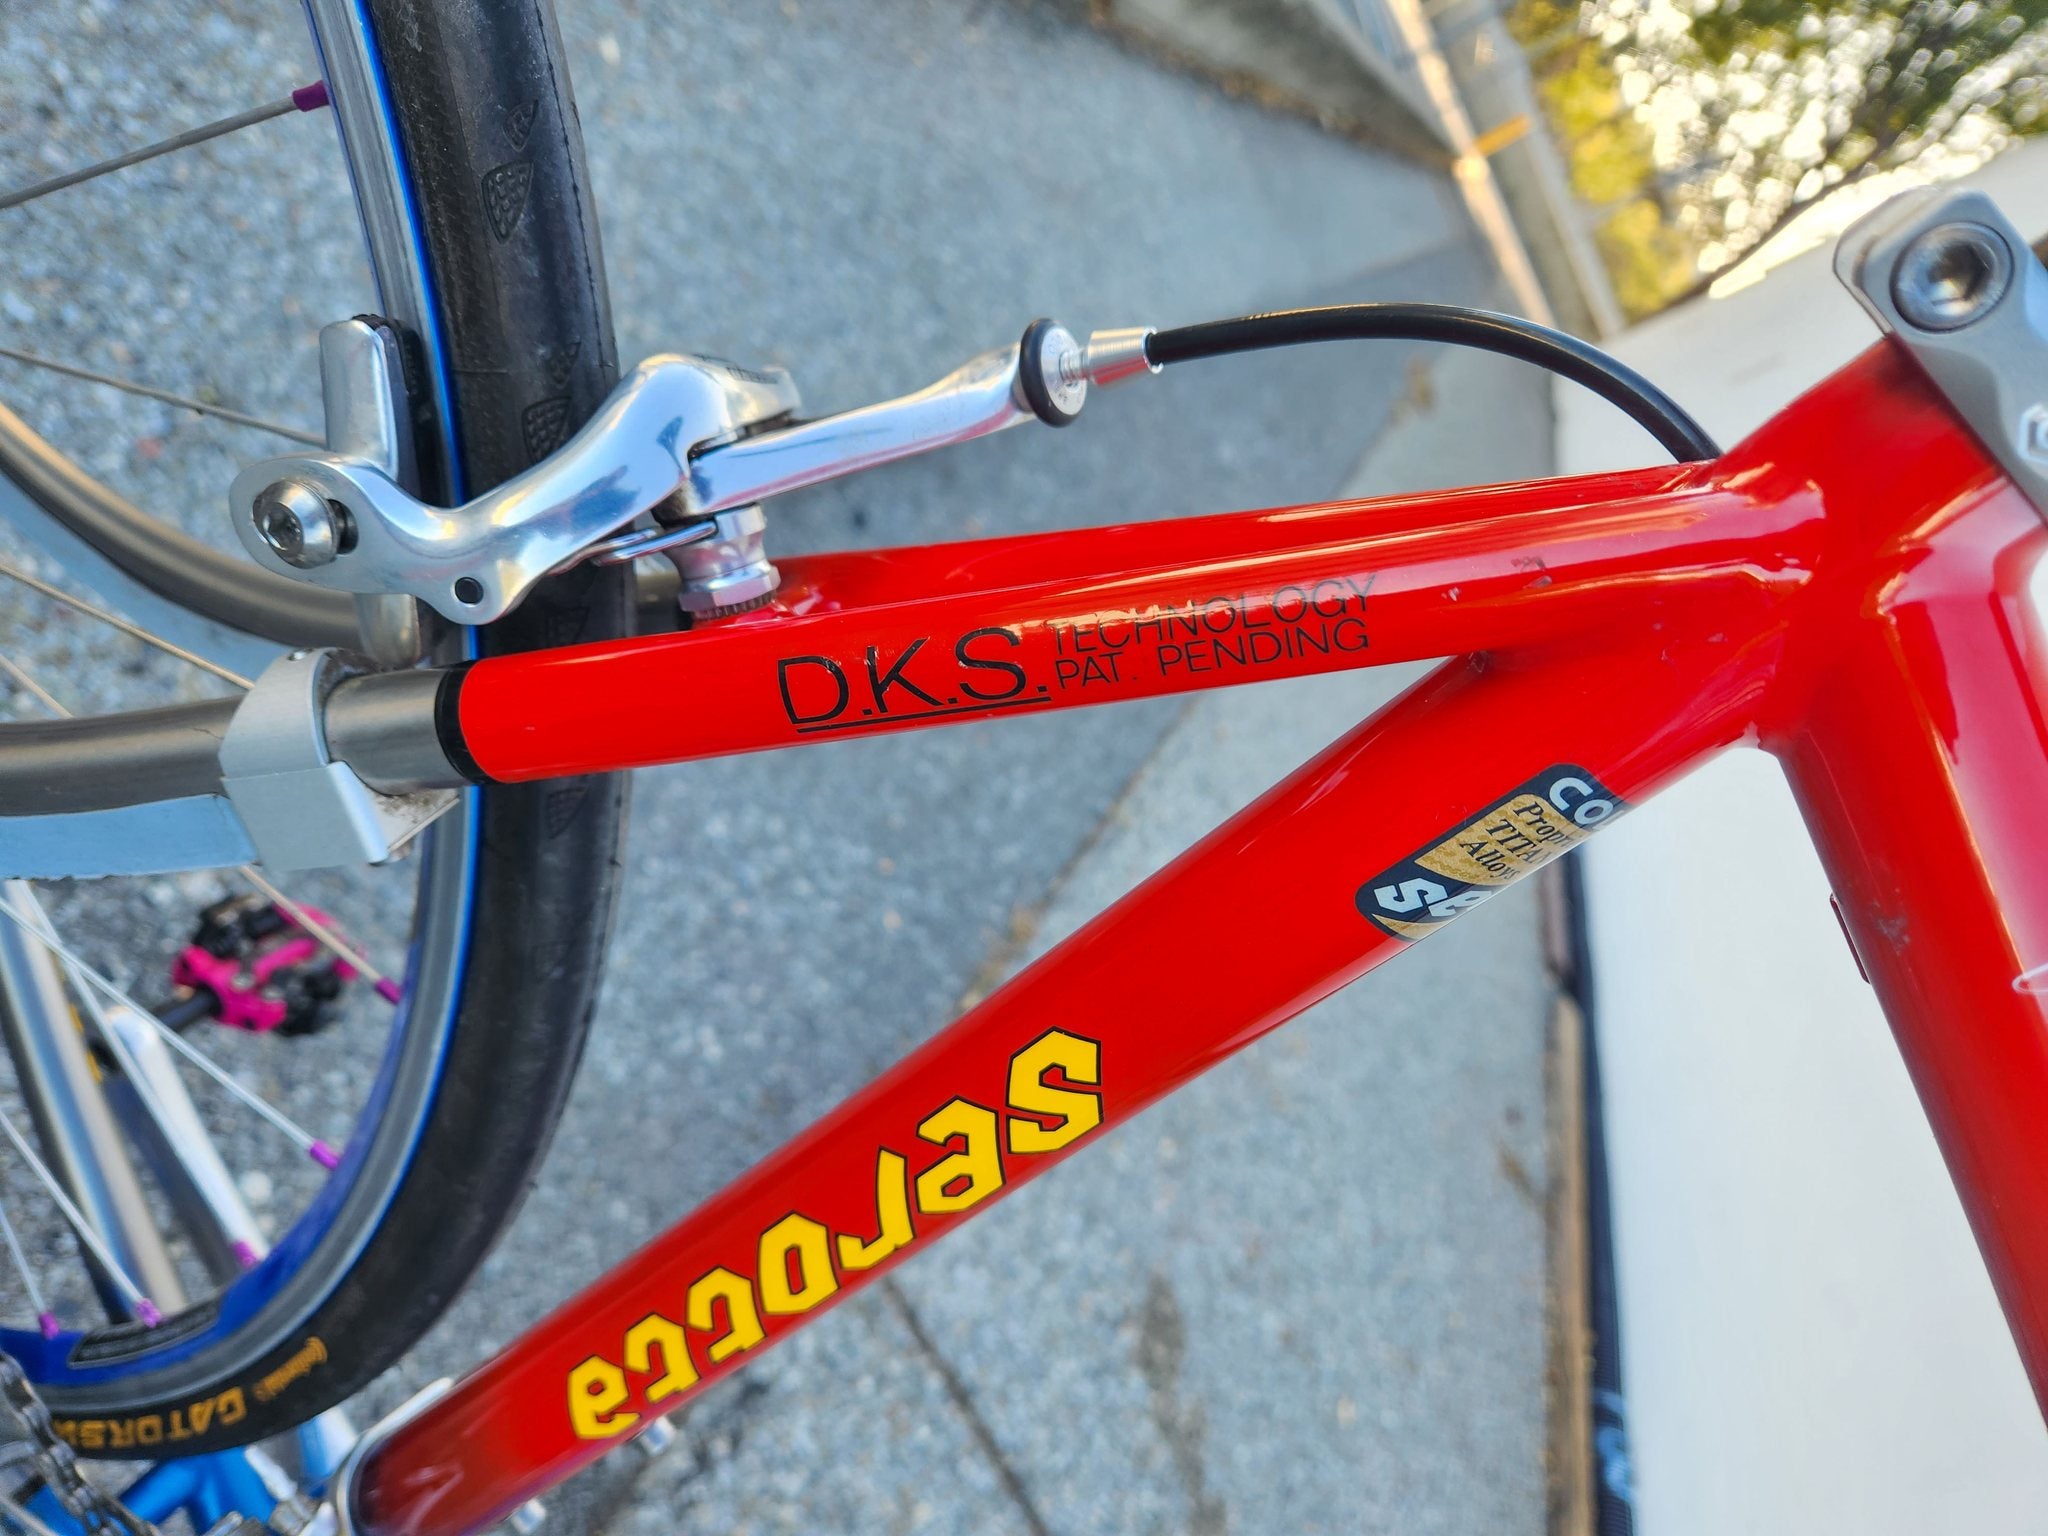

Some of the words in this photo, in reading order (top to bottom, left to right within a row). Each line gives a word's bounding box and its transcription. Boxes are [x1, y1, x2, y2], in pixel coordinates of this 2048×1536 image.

[1046, 572, 1377, 655] TECHNOLOGY
[1158, 617, 1370, 676] PENDING
[777, 627, 1050, 727] D.K.S.
[1459, 841, 1520, 880] Alloys
